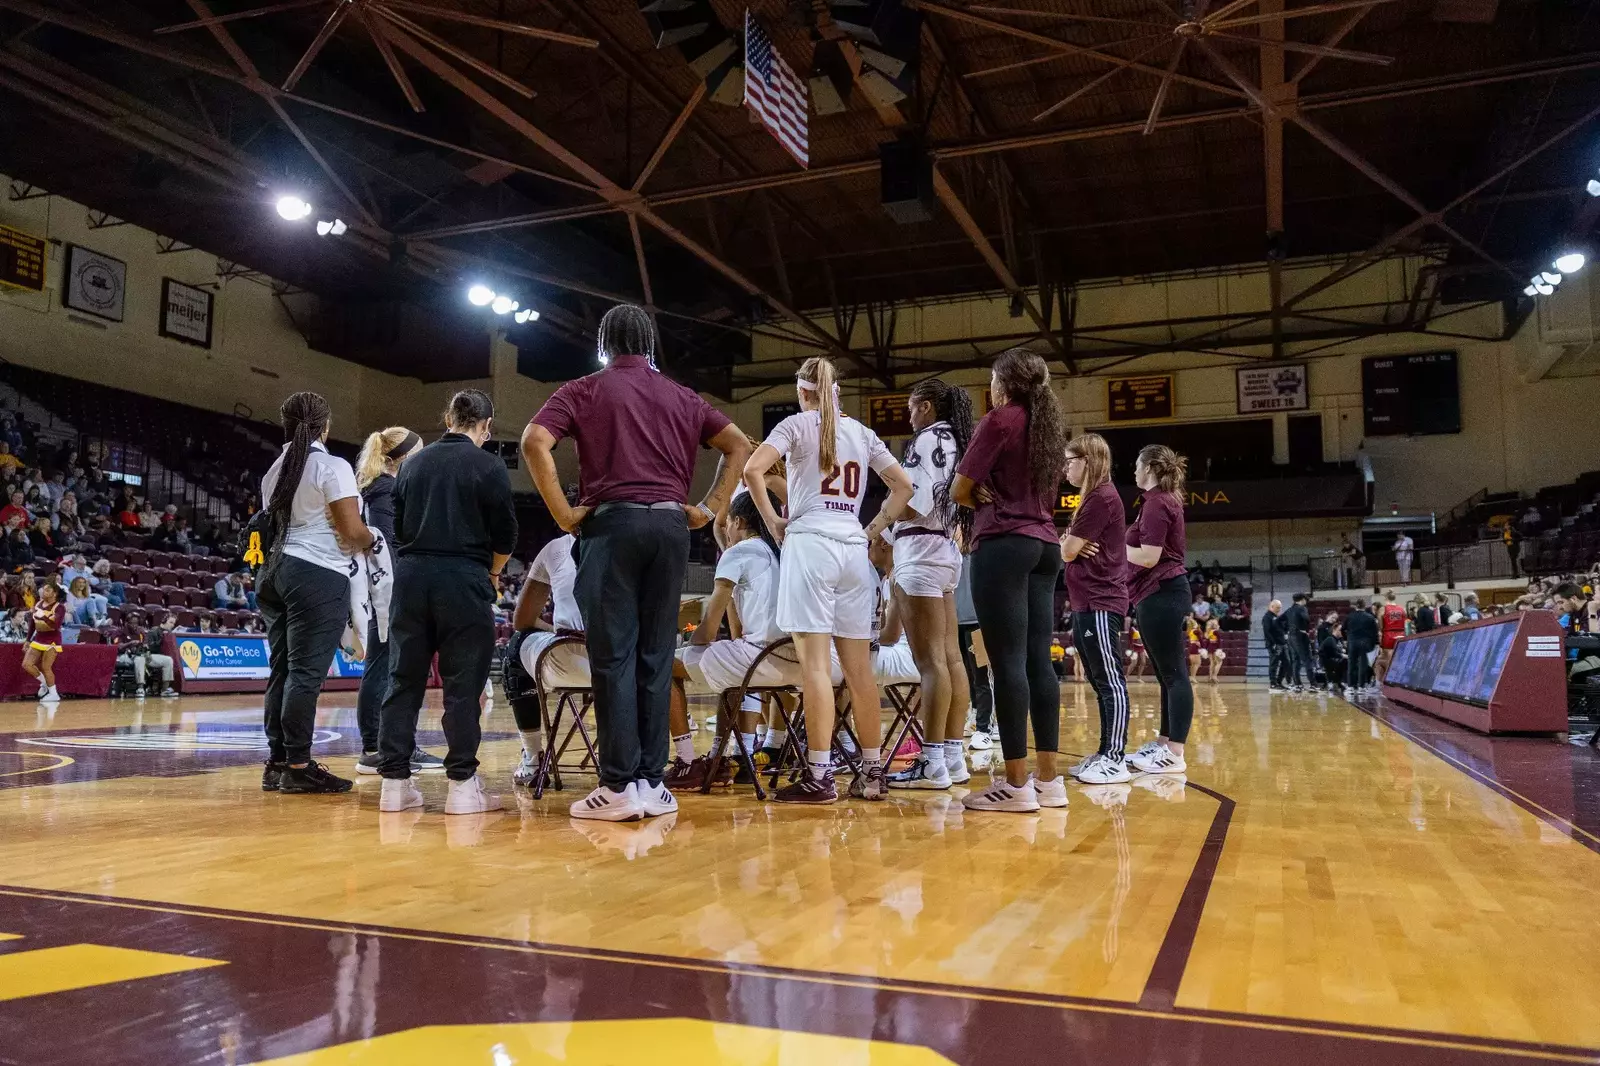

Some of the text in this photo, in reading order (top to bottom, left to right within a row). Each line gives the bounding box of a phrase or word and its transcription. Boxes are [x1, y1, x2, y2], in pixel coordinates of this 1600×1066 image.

[167, 302, 207, 322] meijer
[1251, 397, 1295, 409] SWEET 16
[820, 461, 861, 499] 20
[1133, 491, 1231, 508] ANA
[182, 646, 199, 659] My
[203, 645, 261, 658] Go-To Place
[215, 658, 224, 667] My
